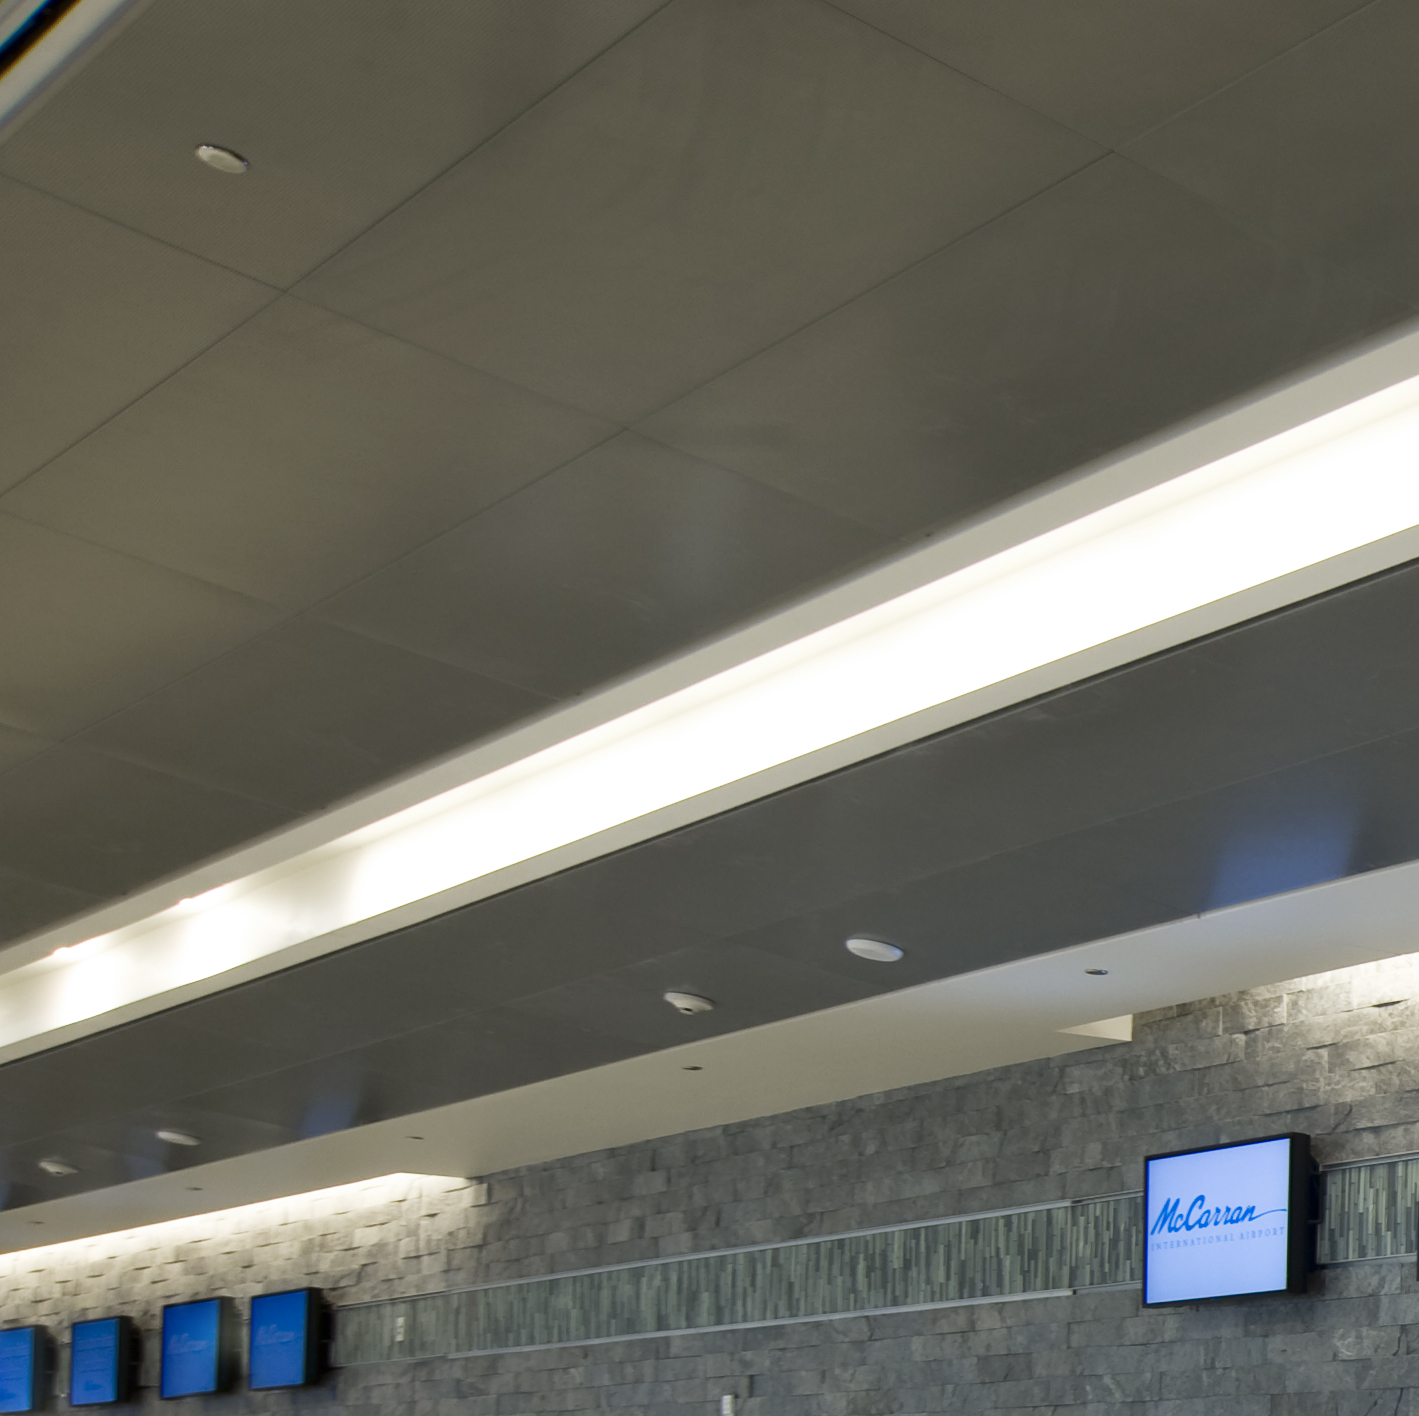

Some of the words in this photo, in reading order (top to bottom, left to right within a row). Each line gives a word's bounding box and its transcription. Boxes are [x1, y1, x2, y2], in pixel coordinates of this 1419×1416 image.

[1151, 1194, 1287, 1235] McCarran
[1151, 1233, 1234, 1251] INTERNATIONAL
[1239, 1227, 1285, 1240] AIRPORT
